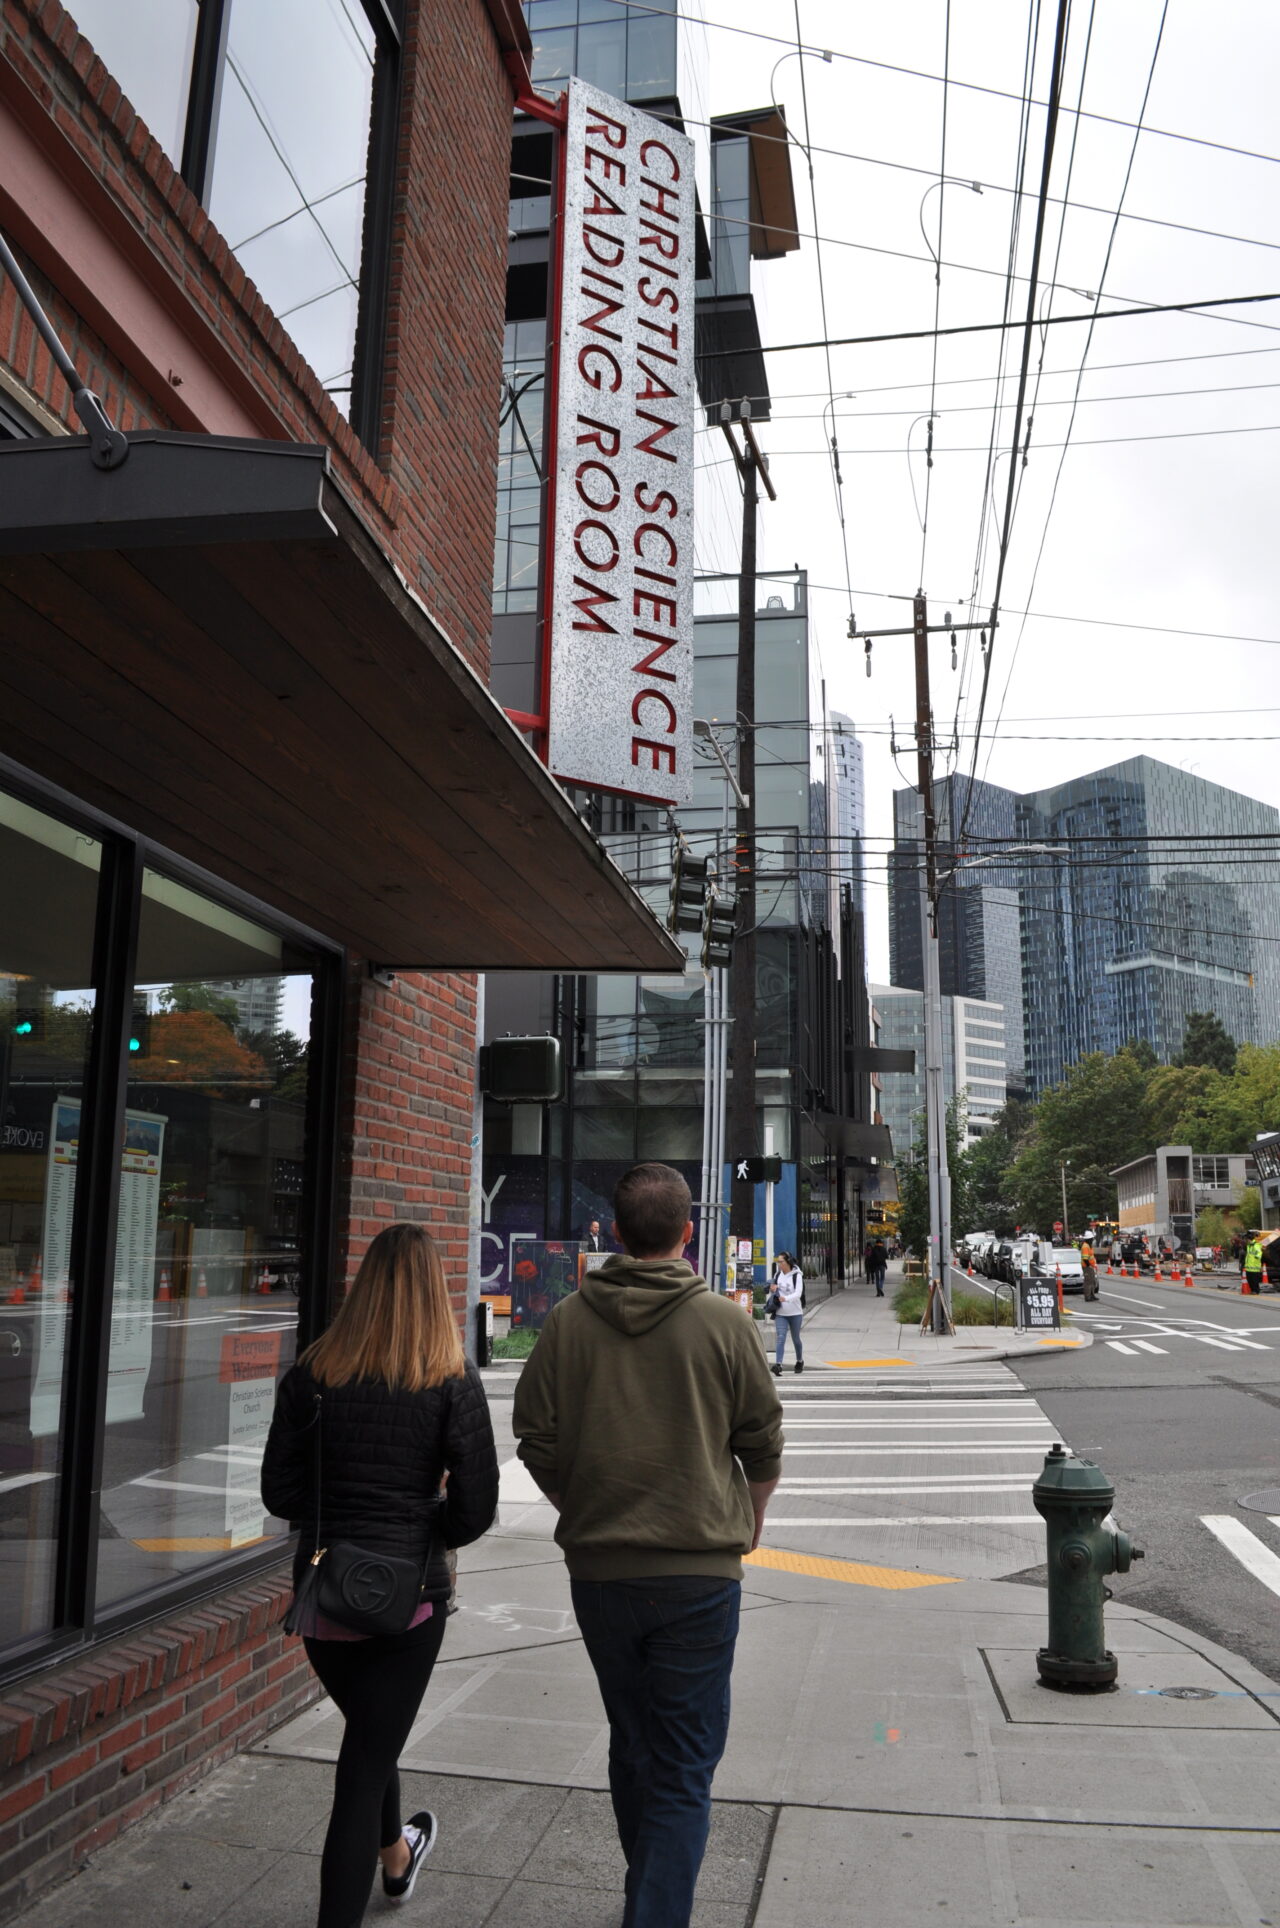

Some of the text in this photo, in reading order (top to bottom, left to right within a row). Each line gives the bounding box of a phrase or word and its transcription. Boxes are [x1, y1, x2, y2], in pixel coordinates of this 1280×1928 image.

[571, 106, 627, 635] READING ROOM
[631, 139, 681, 774] CHRISTIAN SCIENCE
[1027, 1295, 1055, 1307] $5.95
[232, 1338, 274, 1358] Everyone
[232, 1361, 273, 1378] Welcome
[232, 1388, 273, 1402] Christian Science
[243, 1403, 261, 1414] Church
